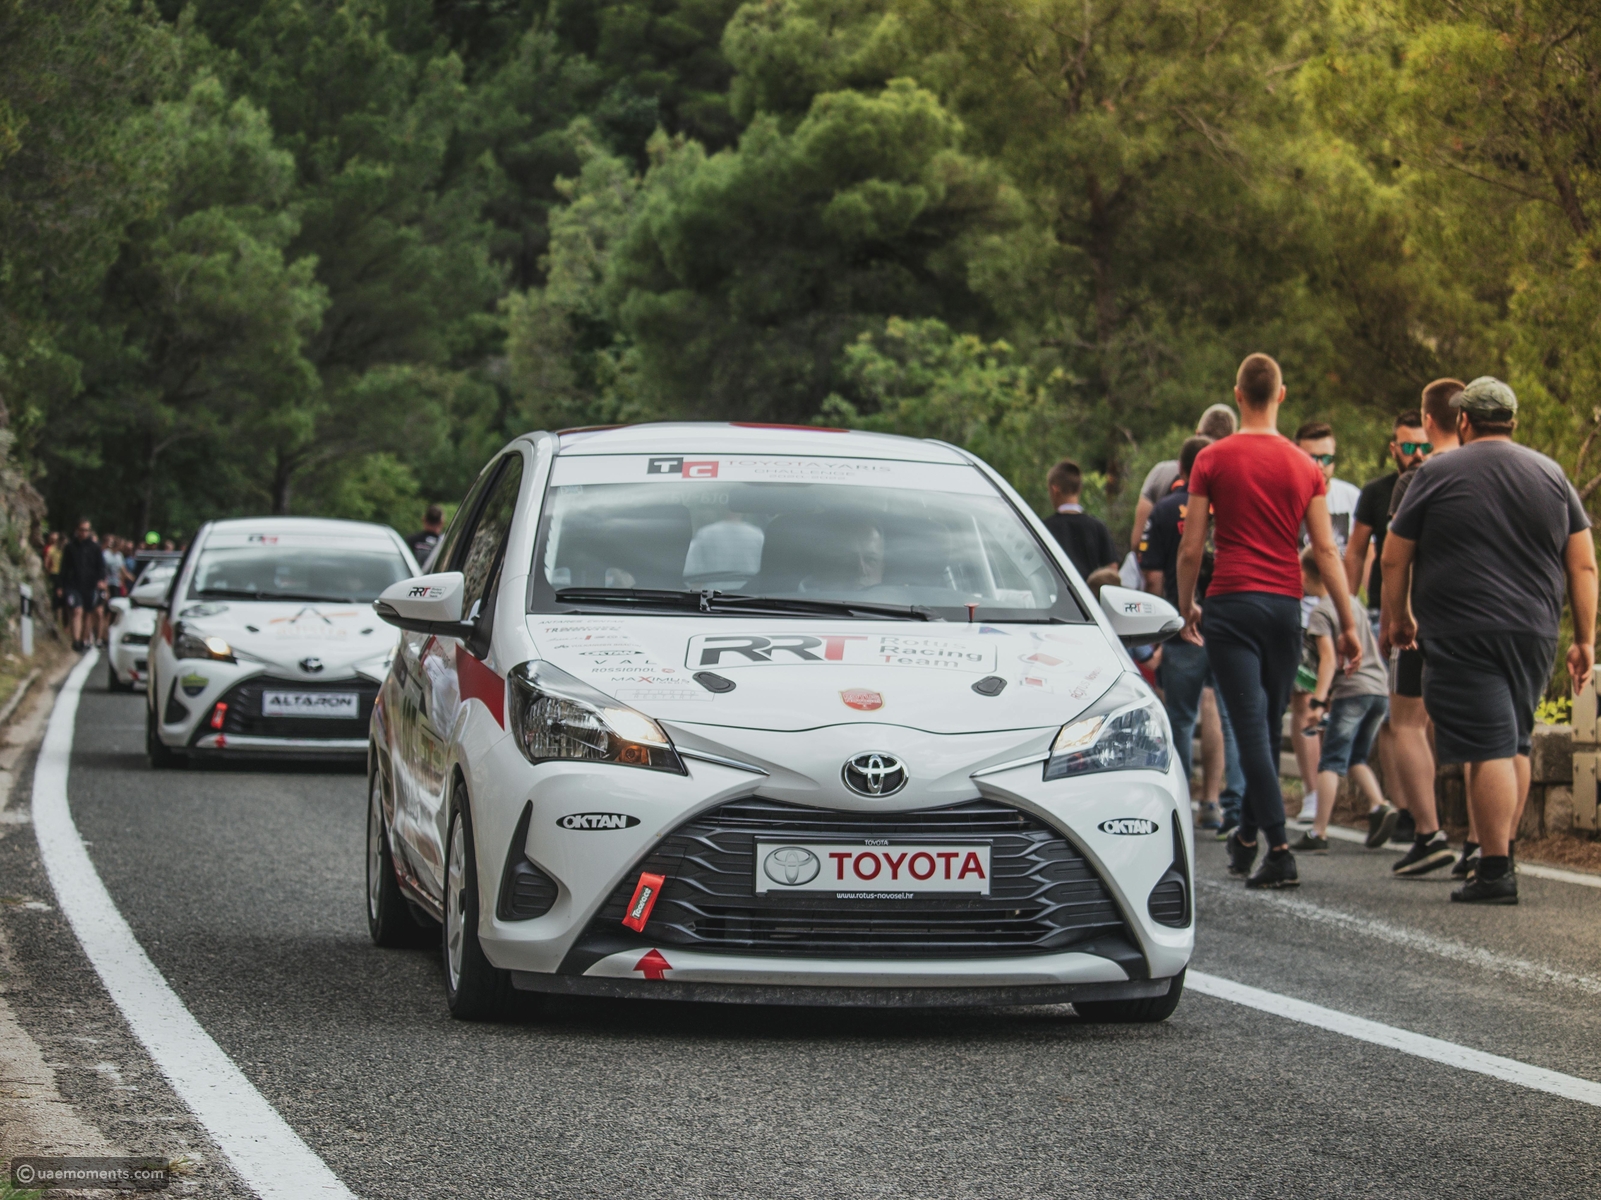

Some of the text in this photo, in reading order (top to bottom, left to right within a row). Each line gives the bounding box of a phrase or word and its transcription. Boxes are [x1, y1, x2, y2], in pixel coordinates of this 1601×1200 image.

[408, 586, 431, 597] RRT
[1124, 602, 1141, 612] RRT
[699, 634, 869, 666] RRT
[879, 636, 967, 650] Rotus
[879, 645, 983, 663] Racing
[879, 654, 959, 669] Team
[562, 814, 628, 829] OKTAN
[1103, 819, 1152, 834] OKTAN
[828, 851, 986, 881] TOYOTA
[836, 891, 914, 900] www.rotus-novosel.hr
